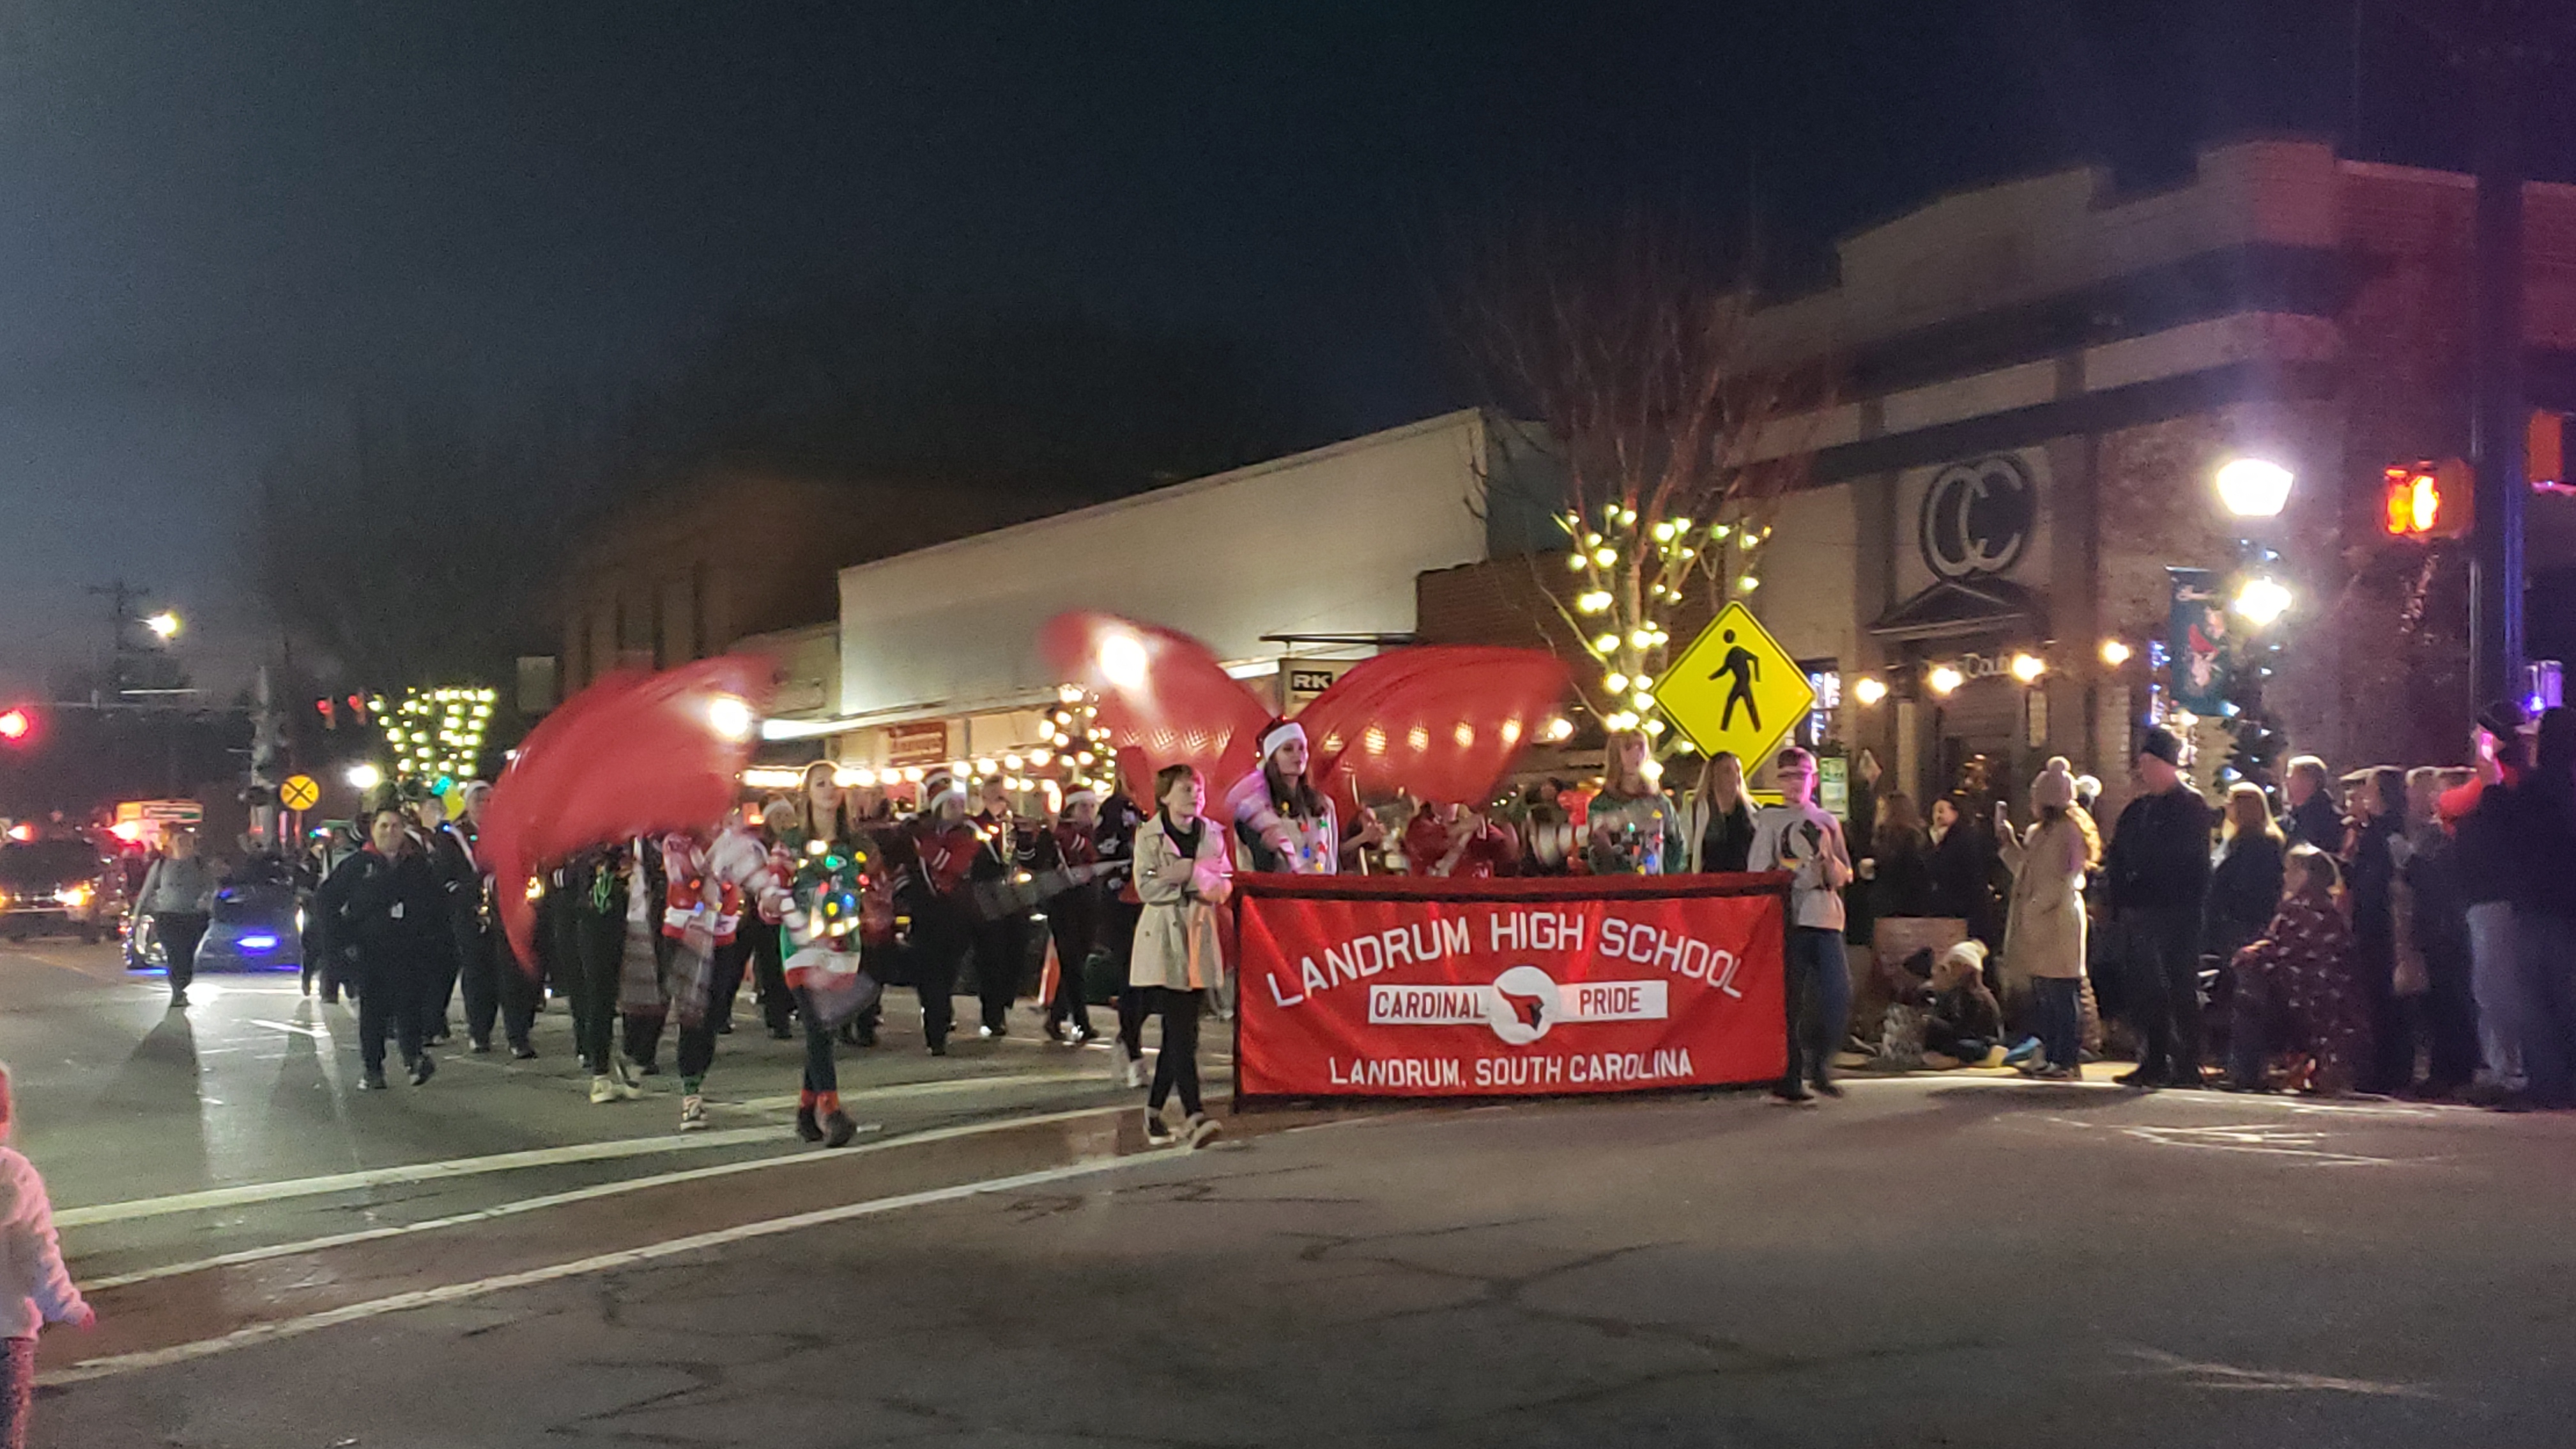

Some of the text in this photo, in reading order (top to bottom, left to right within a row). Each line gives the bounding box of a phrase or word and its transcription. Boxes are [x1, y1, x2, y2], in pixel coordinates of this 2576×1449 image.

[1292, 673, 1332, 689] RK
[1266, 912, 1742, 1007] LANDRUM HIGH SCHOOL
[1374, 991, 1487, 1020] CARDINAL
[1579, 986, 1642, 1016] PRIDE
[1475, 1056, 1563, 1086] SOUTH
[1569, 1048, 1694, 1082] CAROLINA
